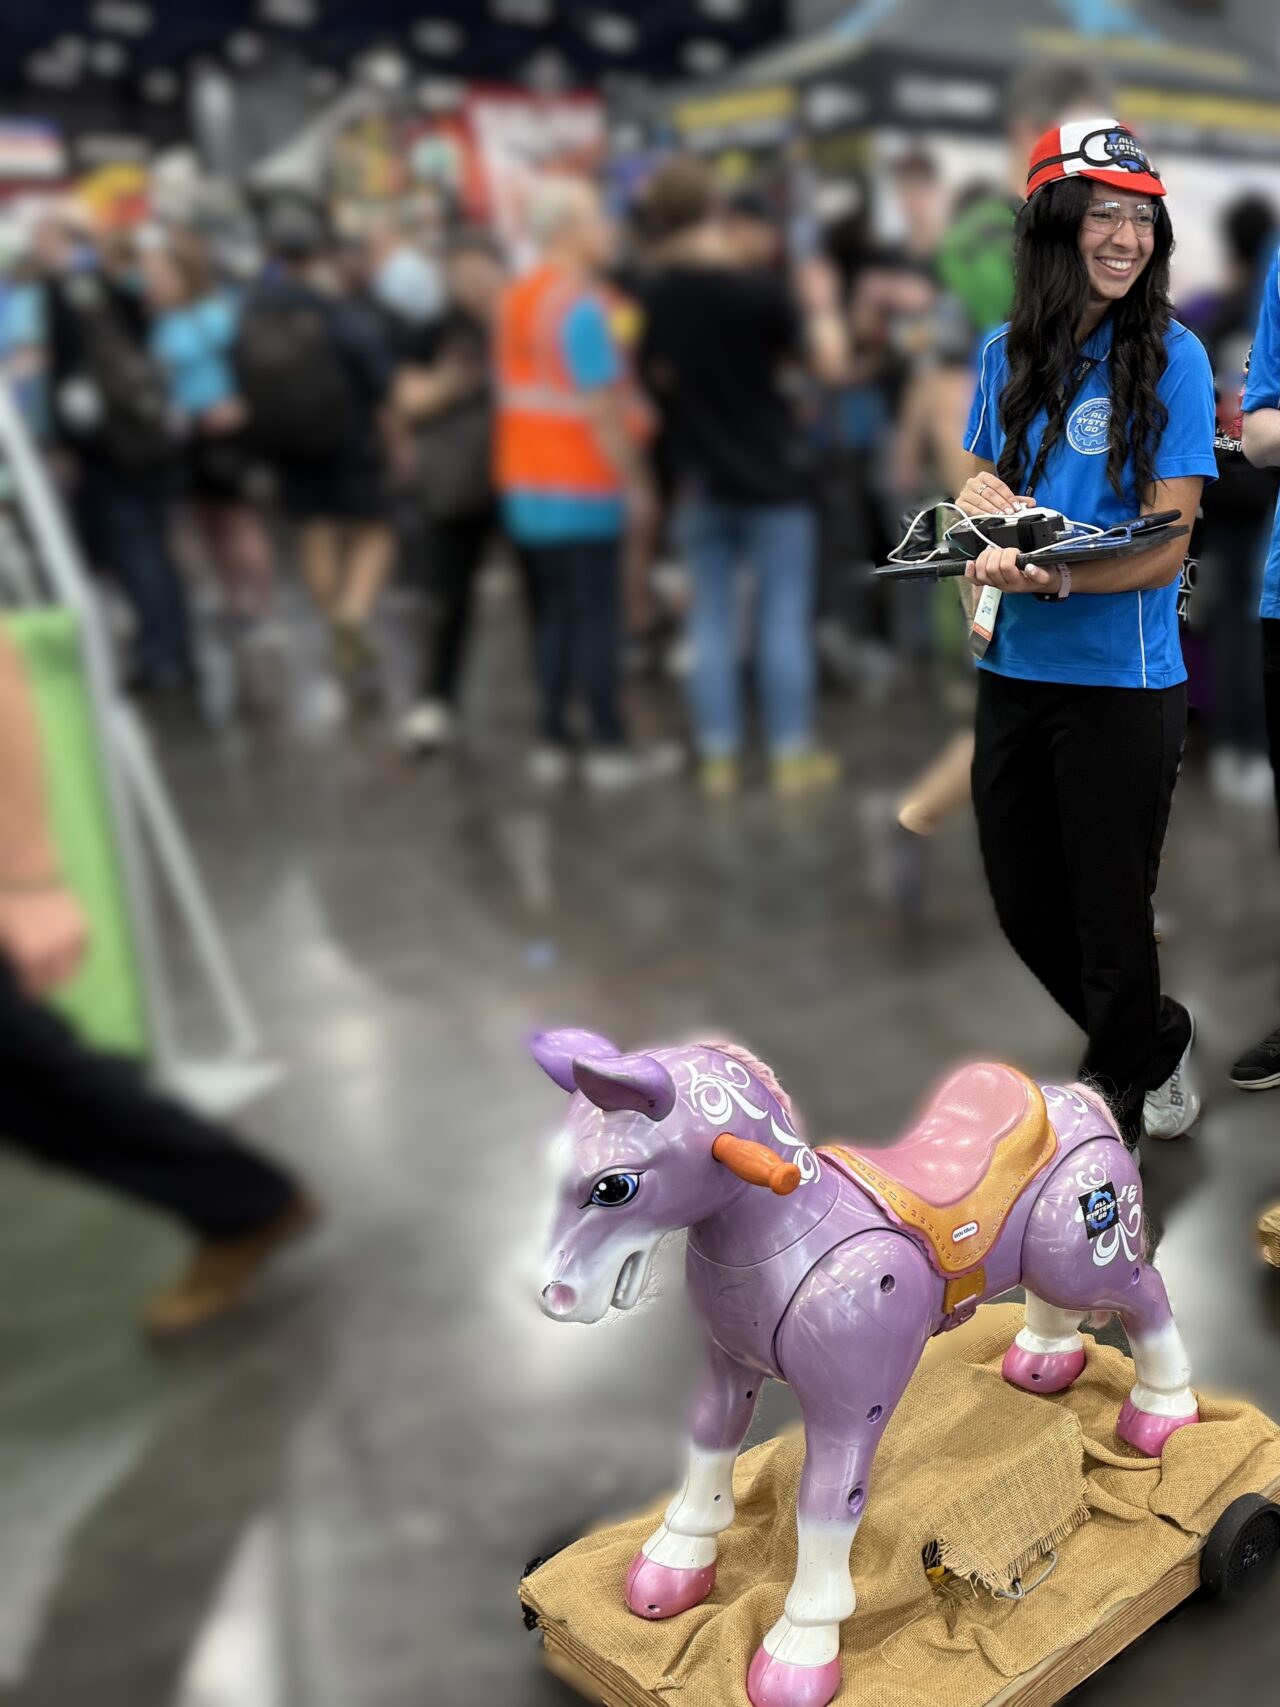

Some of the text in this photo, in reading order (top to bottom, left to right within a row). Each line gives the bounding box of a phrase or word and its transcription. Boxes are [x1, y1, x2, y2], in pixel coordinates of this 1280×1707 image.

[1118, 137, 1135, 146] ALL
[1090, 412, 1108, 420] ALL
[1084, 425, 1099, 433] GO
[1094, 1200, 1107, 1210] ALL
[1086, 1200, 1116, 1220] SYSTEMS
[1097, 1211, 1108, 1220] GO
